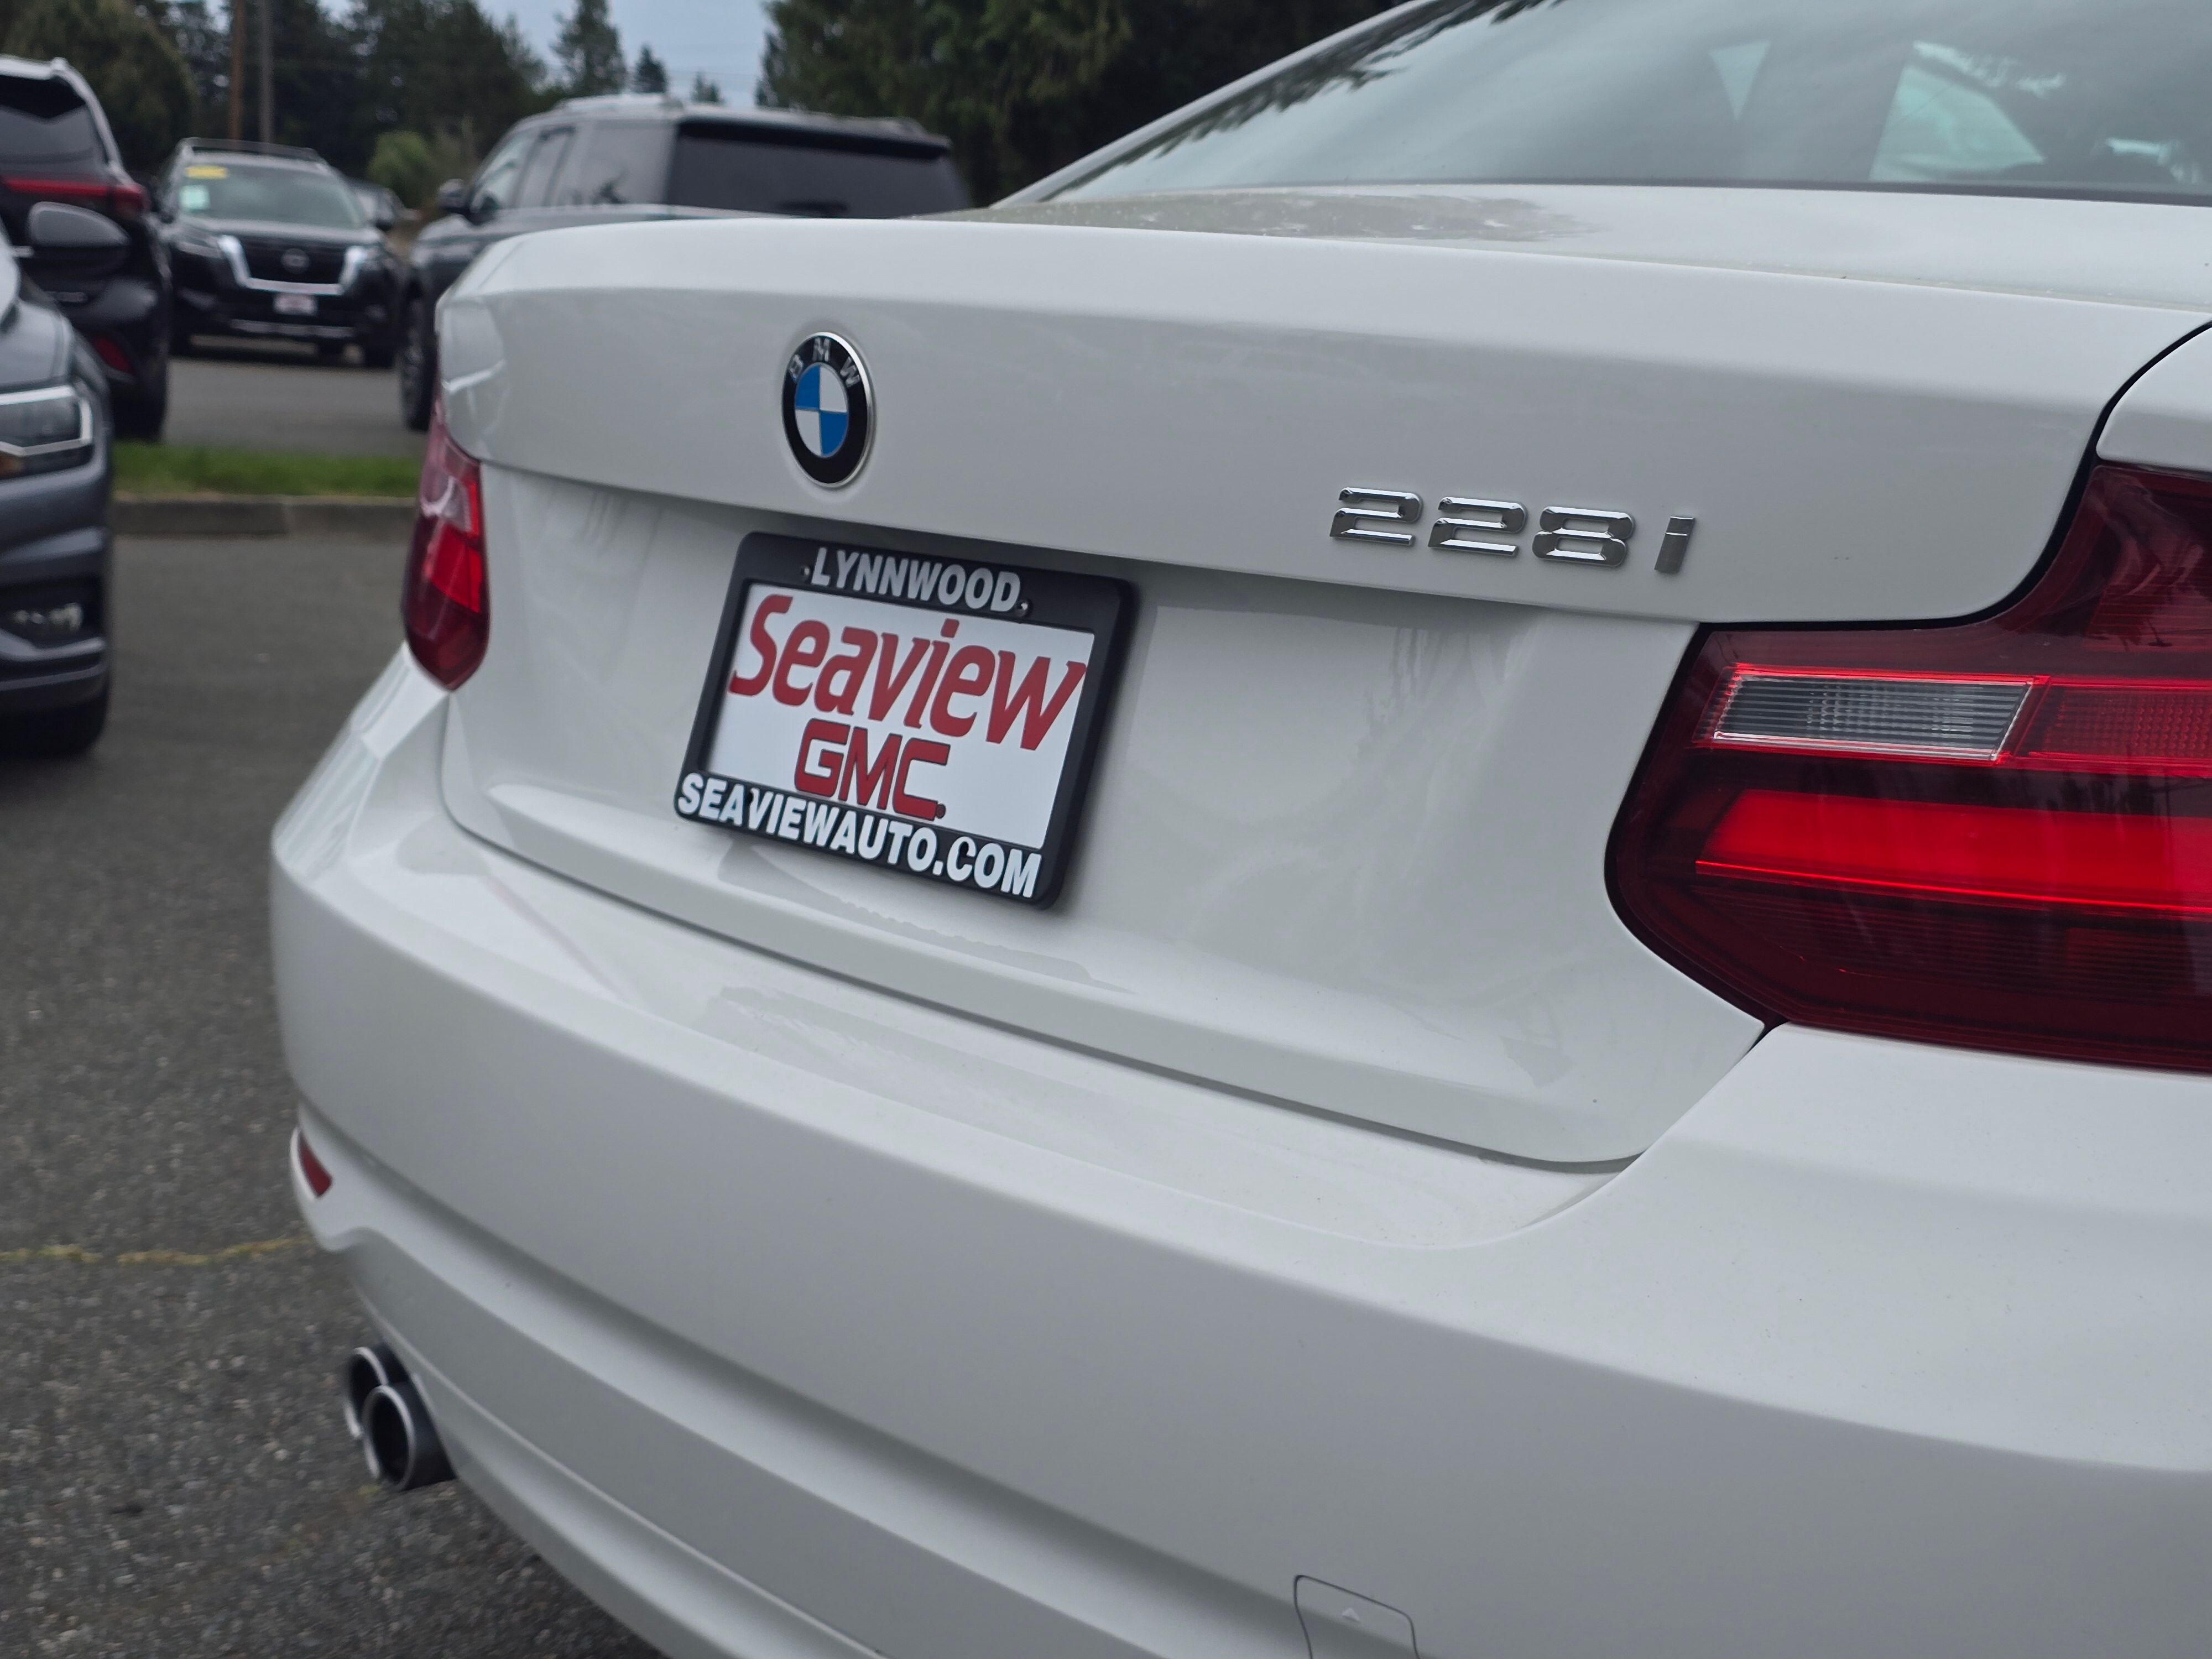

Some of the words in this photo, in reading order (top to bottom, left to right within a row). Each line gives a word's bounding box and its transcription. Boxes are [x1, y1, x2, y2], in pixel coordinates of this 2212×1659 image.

[789, 337, 860, 388] BMW
[1329, 487, 1695, 573] 228i
[810, 546, 1021, 613] LYNNWOOD
[727, 593, 1087, 752] Seaview
[794, 718, 951, 821] GMC
[678, 773, 1042, 898] SEAVIEWAUTO.COM
